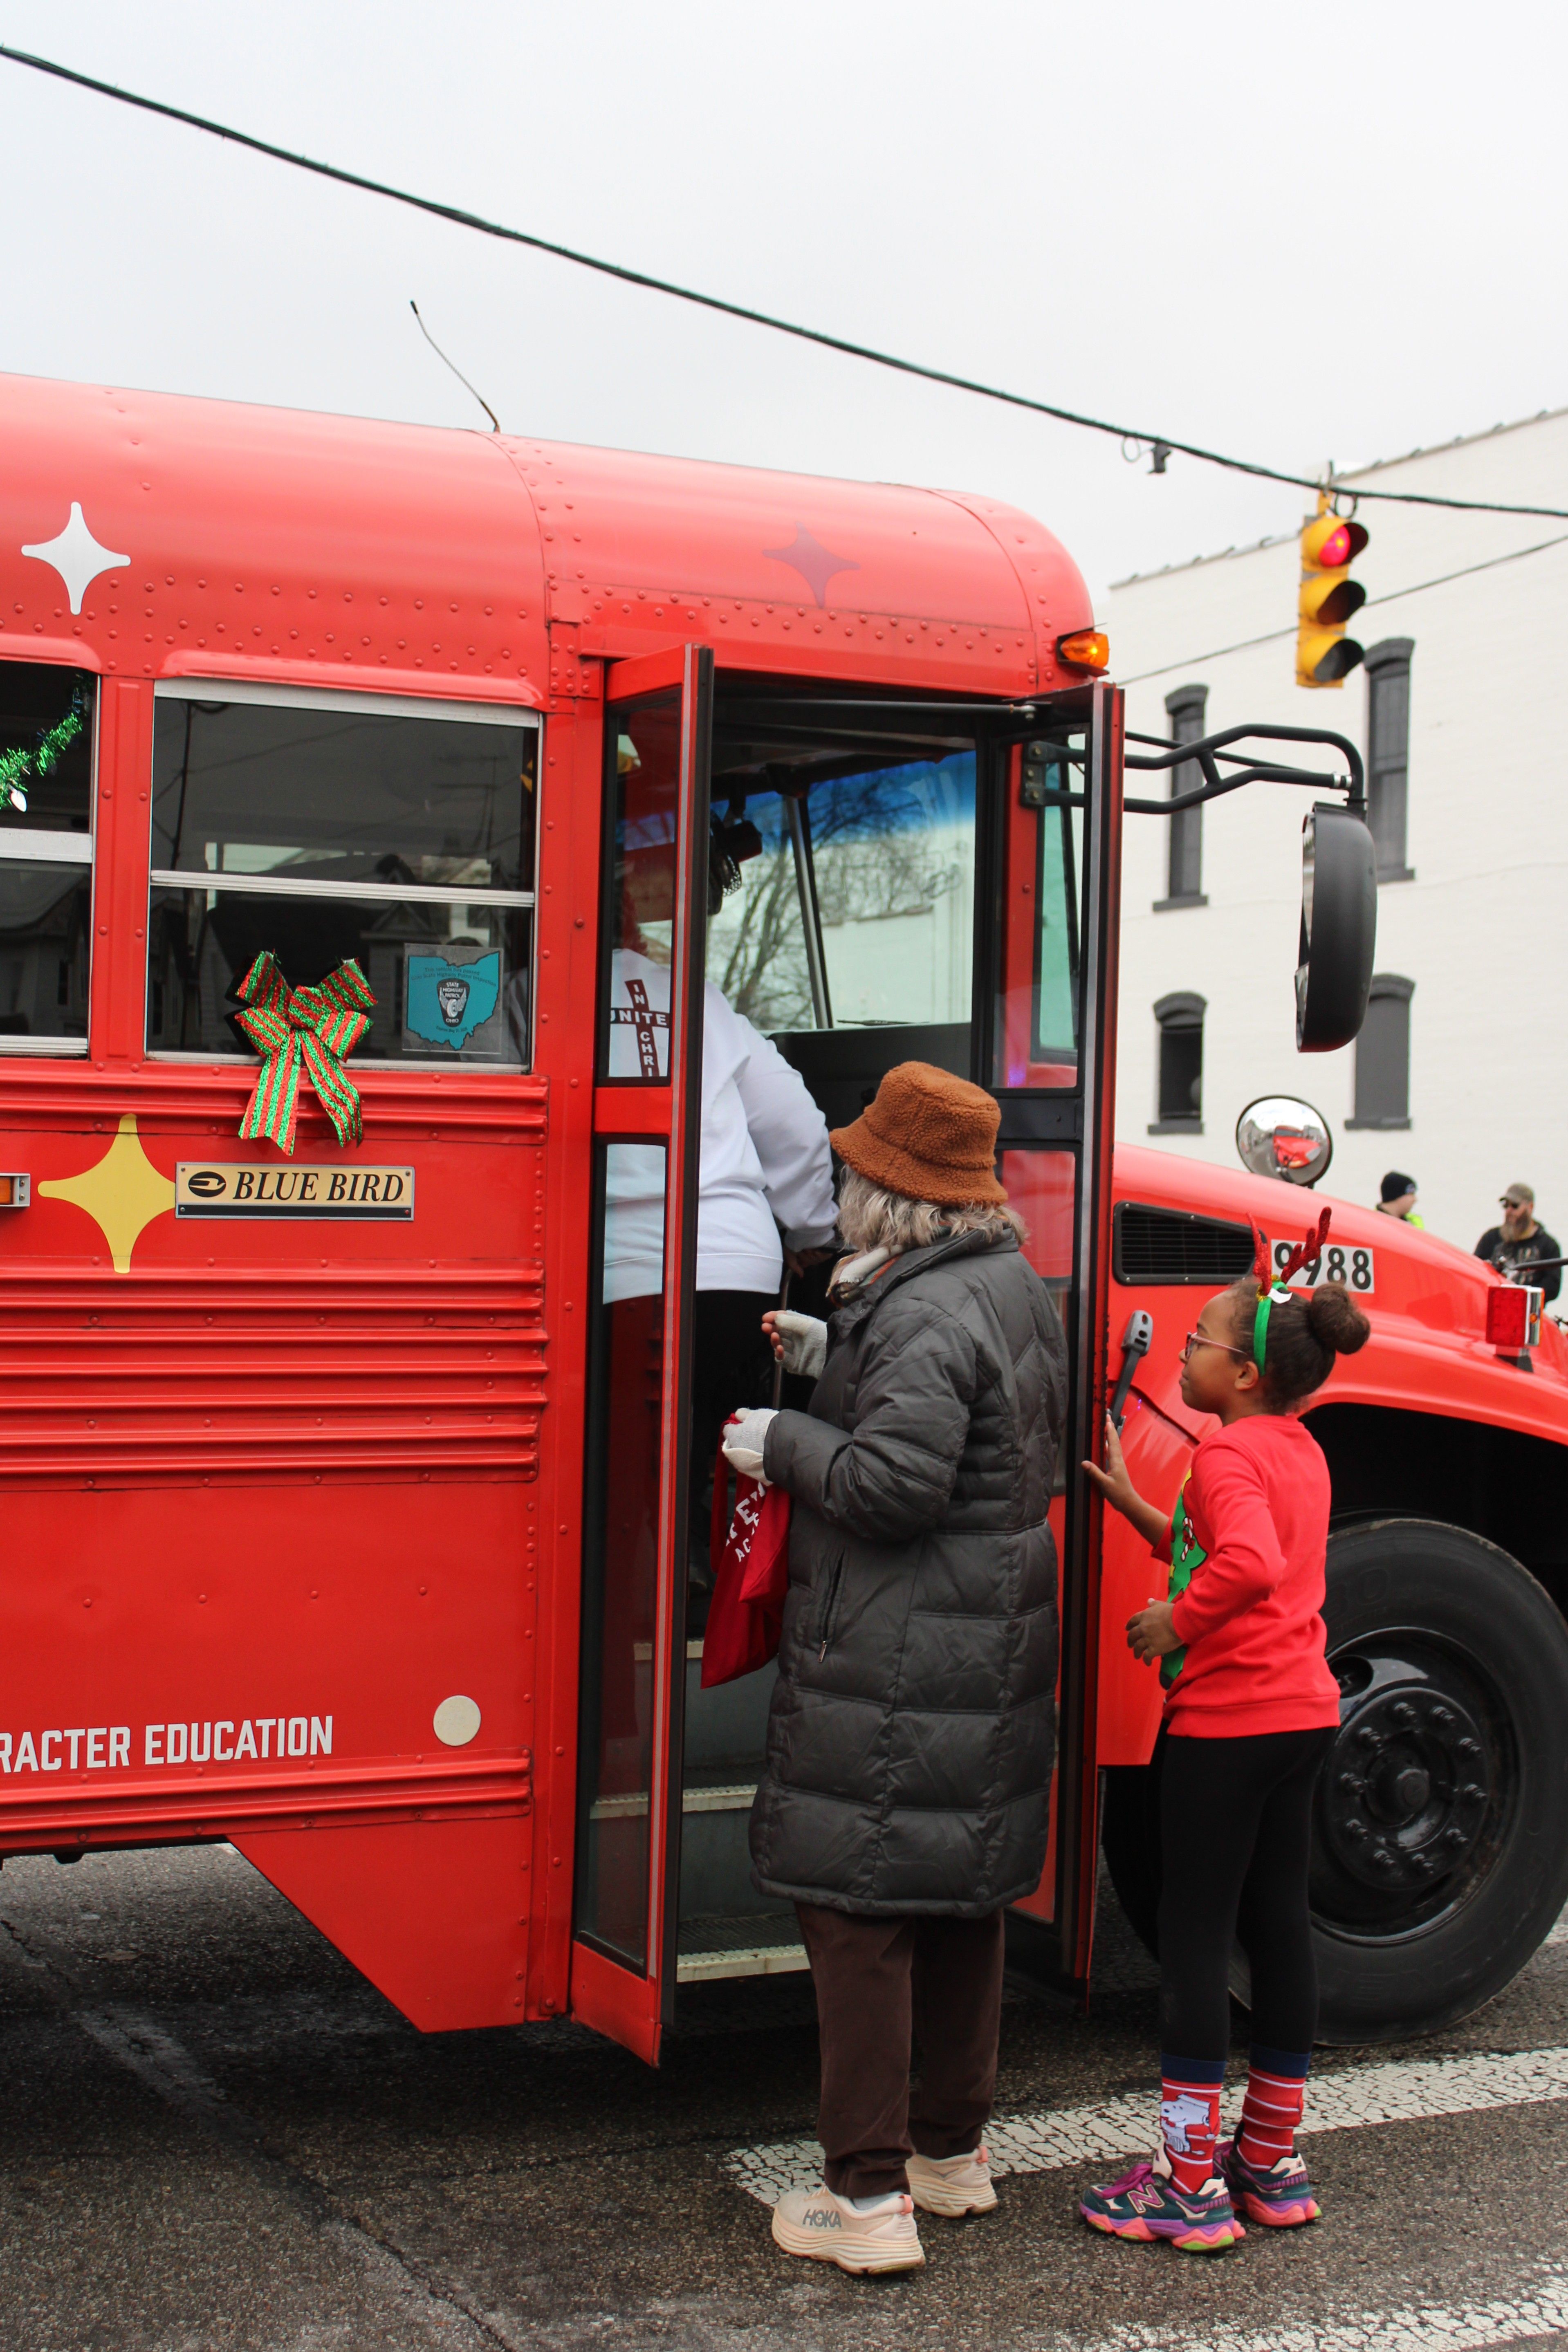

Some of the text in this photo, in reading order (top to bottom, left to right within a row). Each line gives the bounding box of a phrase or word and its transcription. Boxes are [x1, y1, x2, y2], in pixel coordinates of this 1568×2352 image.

[232, 1171, 404, 1202] BLUE BIRD
[0, 1715, 333, 1774] RACTER EDUCATION
[802, 2208, 841, 2228] HOKA
